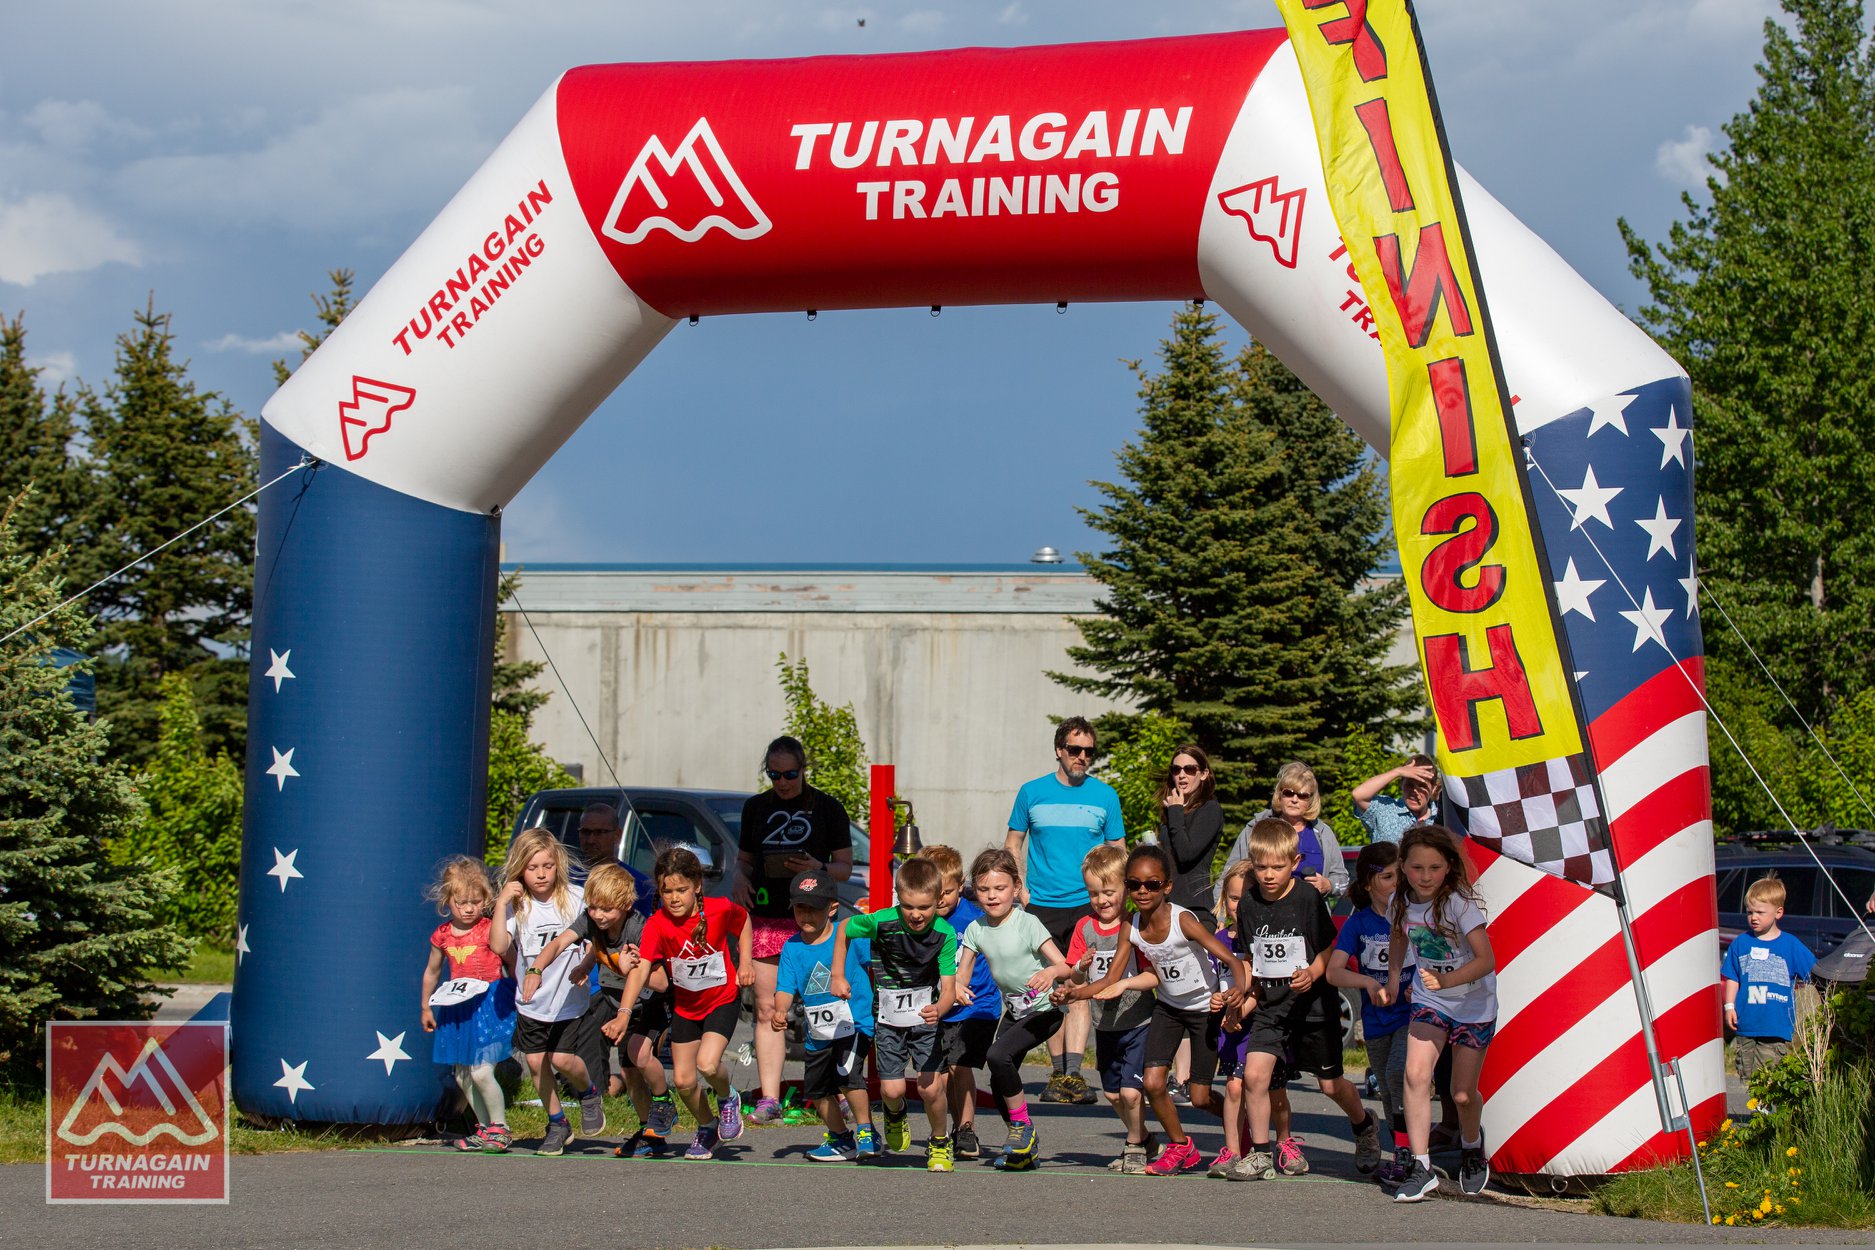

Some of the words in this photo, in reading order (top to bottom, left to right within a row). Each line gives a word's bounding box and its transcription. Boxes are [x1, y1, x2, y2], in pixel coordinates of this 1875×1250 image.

[790, 106, 1193, 170] TURNAGAIN
[856, 172, 1120, 221] TRAINING
[391, 178, 554, 357] TURNAGAIN
[436, 233, 546, 350] TRAINING
[761, 810, 813, 845] 25
[1264, 943, 1286, 959] 38
[687, 962, 708, 977] 77
[1161, 966, 1180, 979] 16
[451, 982, 468, 993] 14
[1748, 985, 1768, 1005] N
[896, 993, 912, 1010] 71
[809, 1010, 834, 1025] 70
